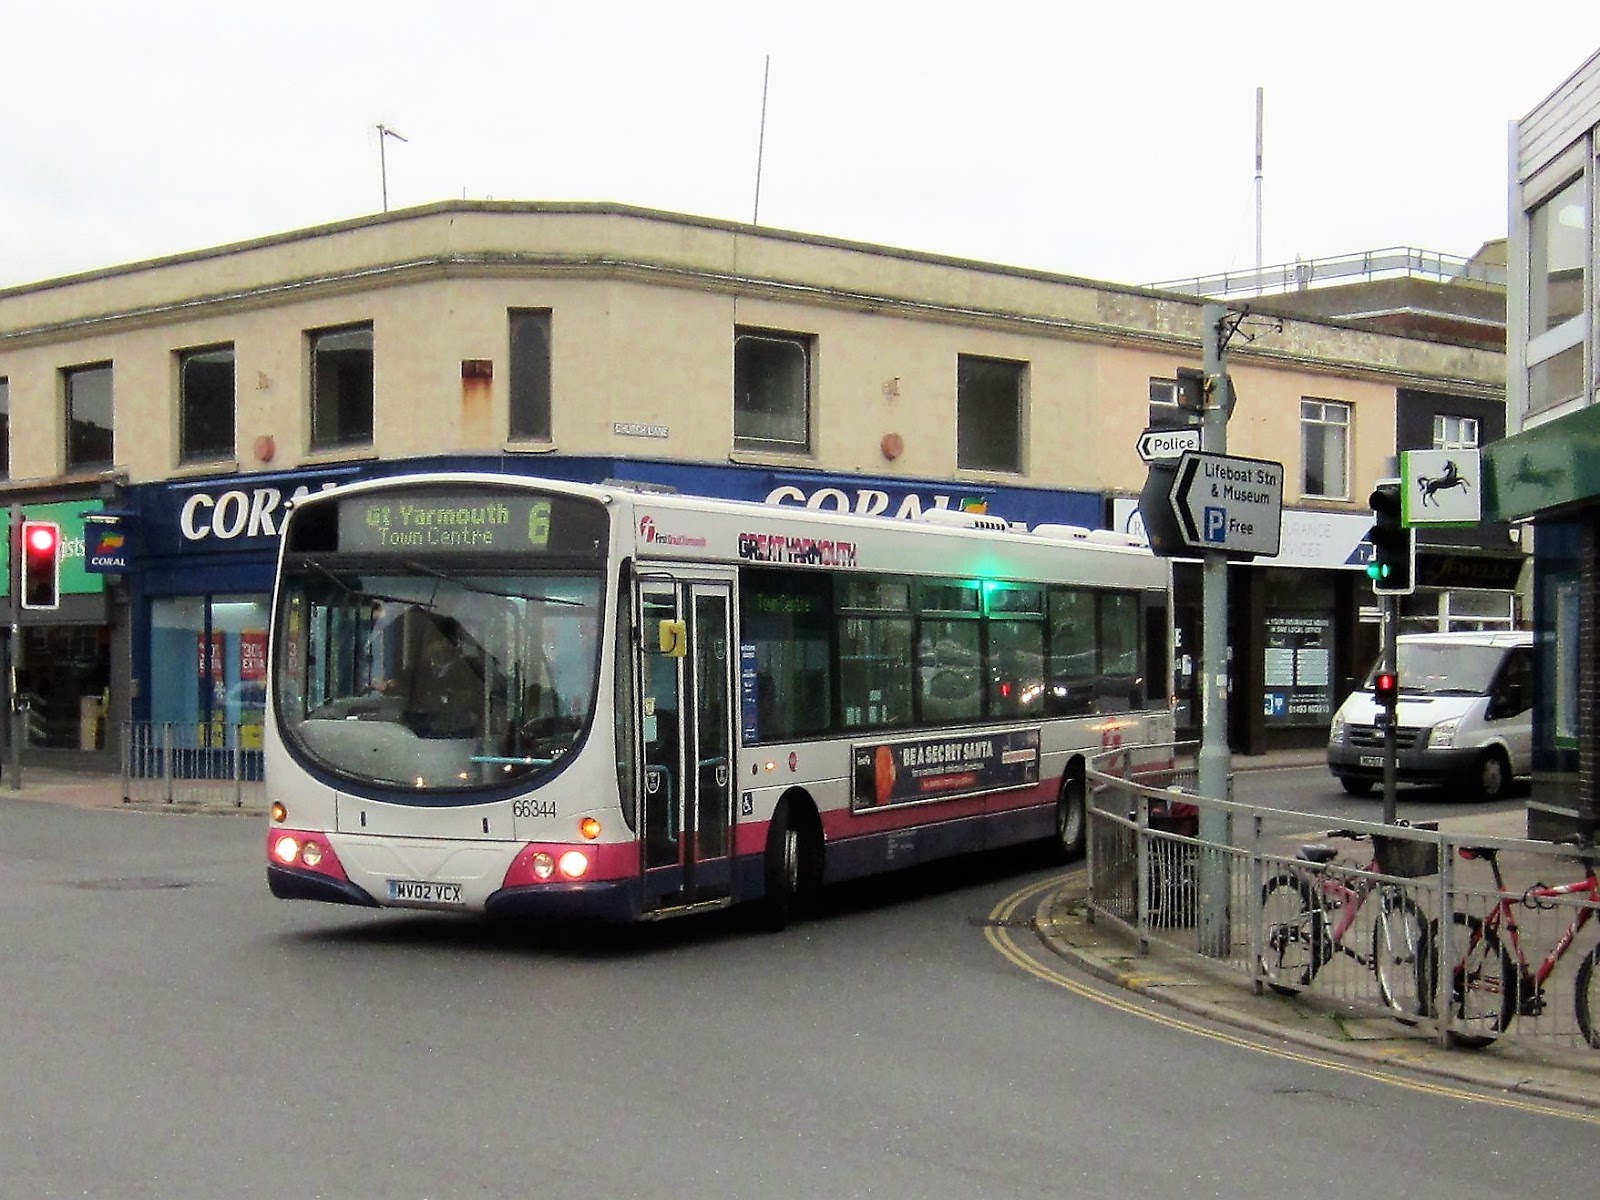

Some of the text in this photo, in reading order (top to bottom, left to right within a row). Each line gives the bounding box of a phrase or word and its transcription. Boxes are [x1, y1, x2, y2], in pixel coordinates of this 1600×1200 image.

[1153, 438, 1195, 451] Police
[1204, 463, 1277, 486] Lifeboat Stn
[1211, 484, 1270, 504] & Museum
[180, 482, 337, 540] COR
[399, 503, 510, 526] Yarmouth
[528, 502, 552, 545] 6
[1229, 517, 1254, 535] Free
[378, 526, 494, 546] Town Centre
[91, 556, 126, 567] CORAL
[926, 743, 962, 764] SECRET
[963, 740, 994, 760] SANTA
[513, 799, 557, 817] 66344
[436, 886, 460, 901] VCX
